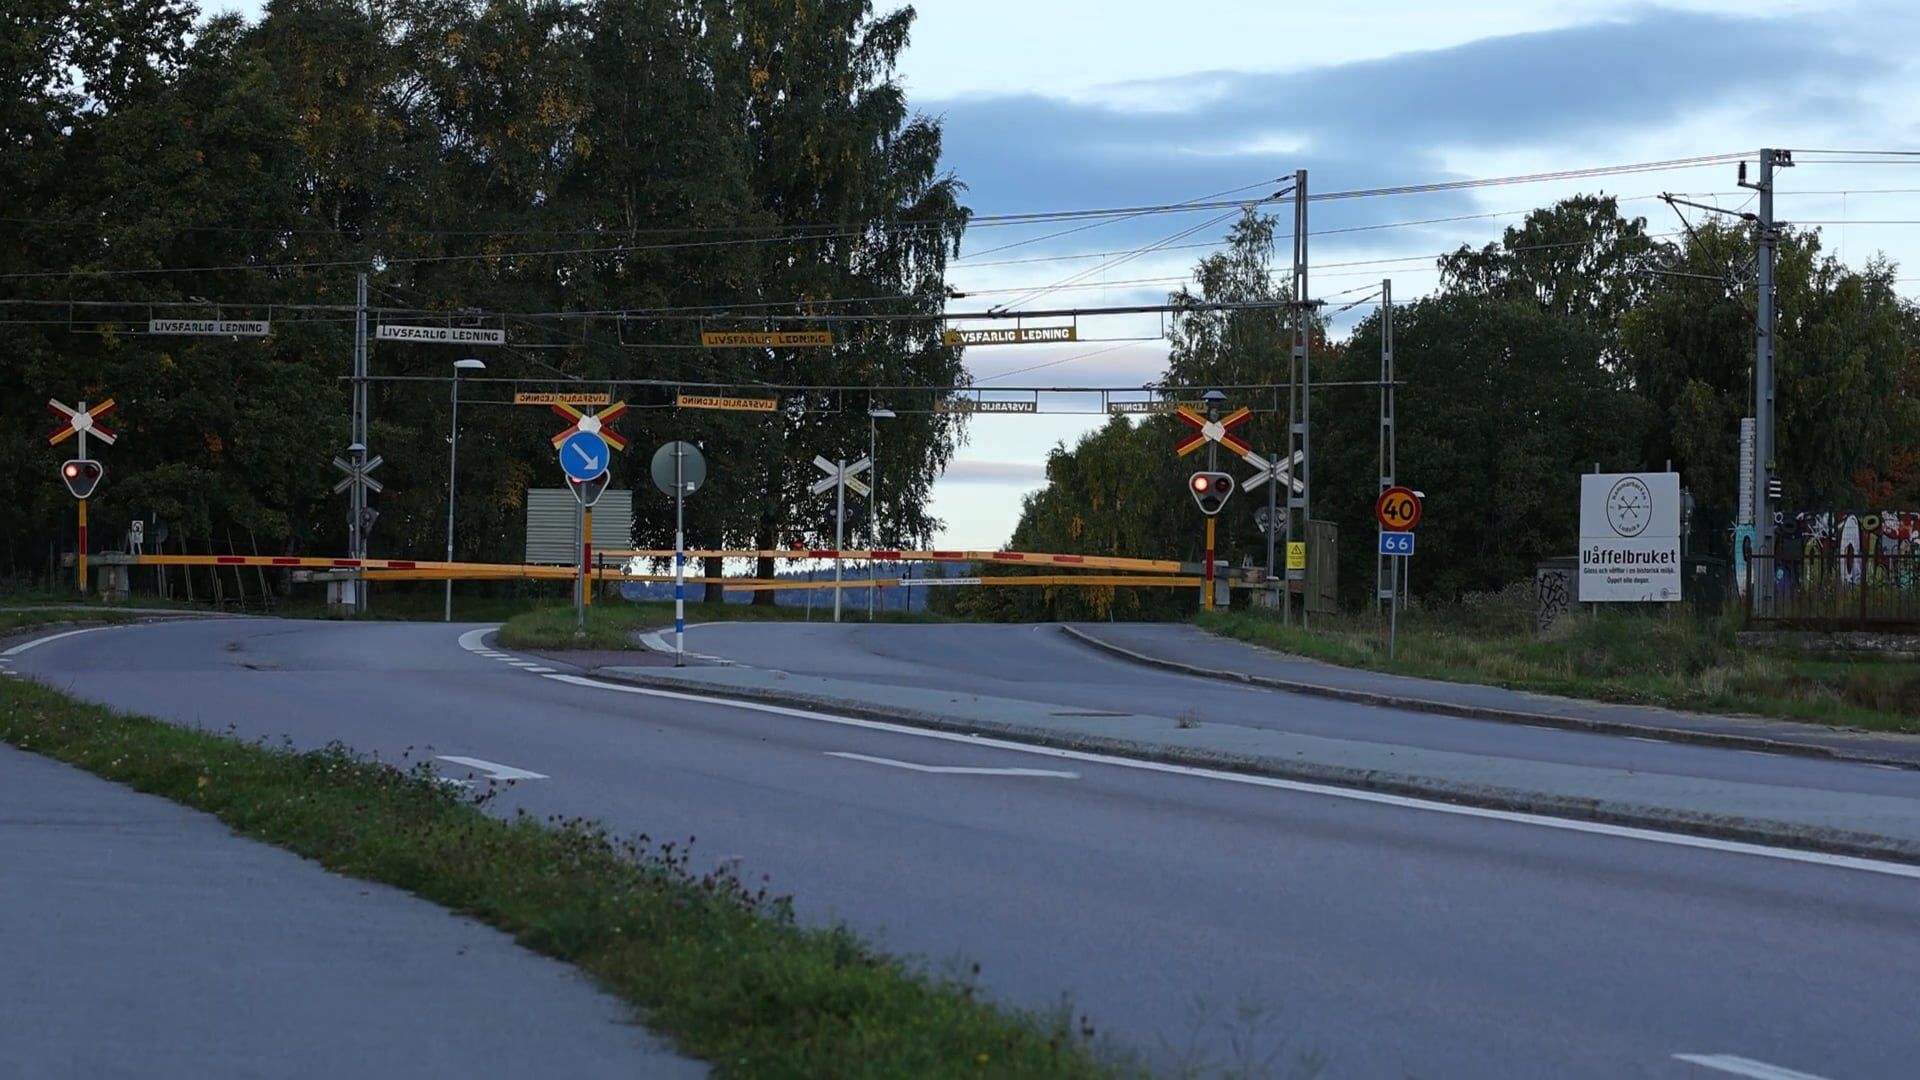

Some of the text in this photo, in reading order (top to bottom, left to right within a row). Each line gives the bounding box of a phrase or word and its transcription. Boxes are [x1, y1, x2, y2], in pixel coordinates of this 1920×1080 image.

[154, 322, 262, 332] LIVSFARLIG LEDNING
[382, 326, 499, 341] LIVSFARLIG LEDNING
[1021, 328, 1070, 340] LEDNING
[1384, 499, 1415, 520] 40
[1385, 537, 1409, 550] 66
[1583, 545, 1676, 564] Våffelbruket
